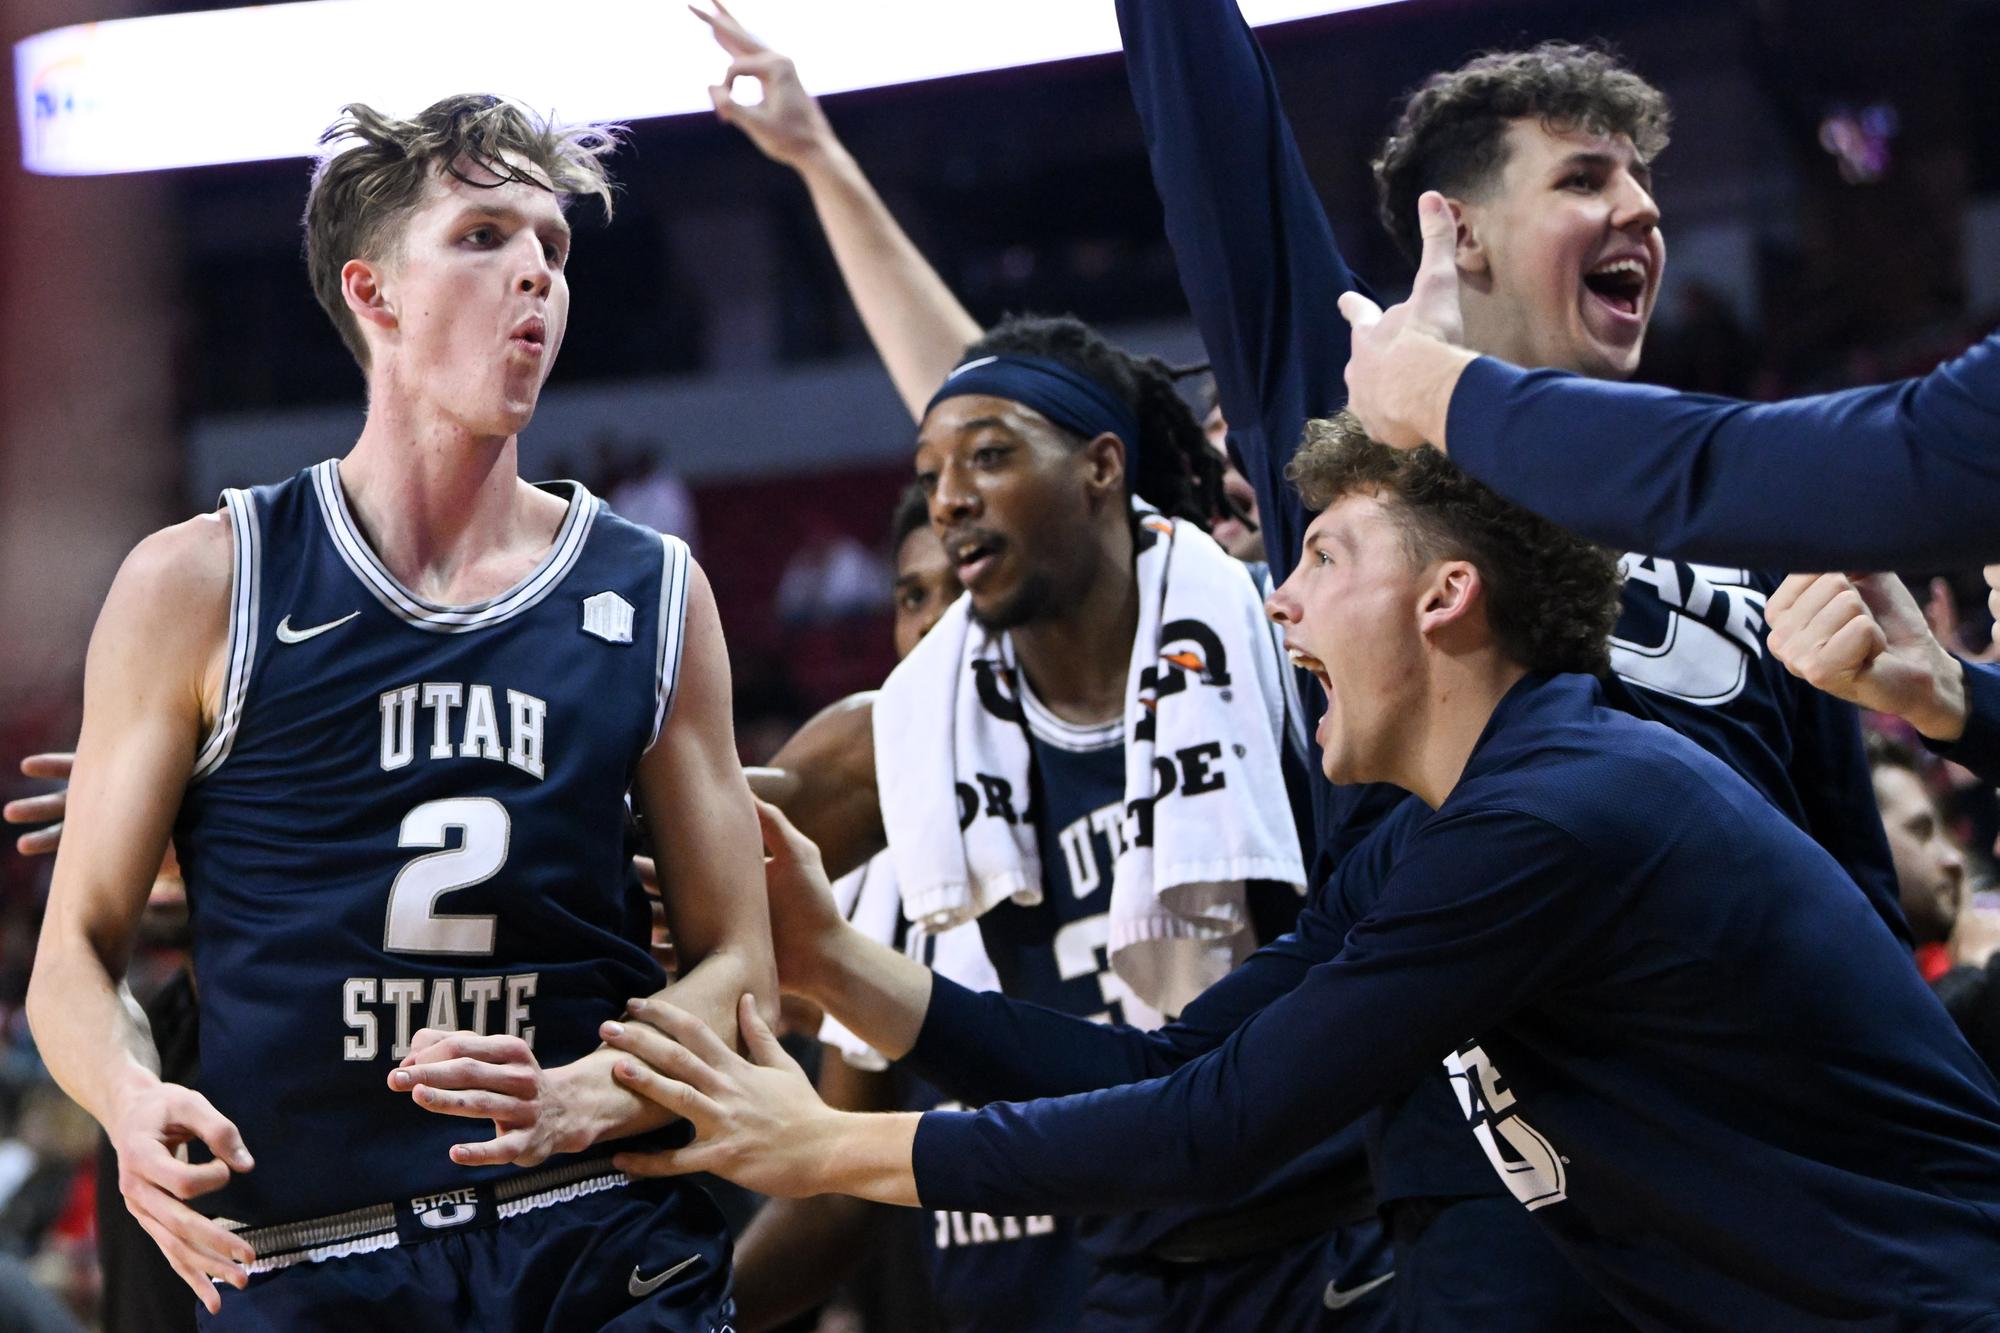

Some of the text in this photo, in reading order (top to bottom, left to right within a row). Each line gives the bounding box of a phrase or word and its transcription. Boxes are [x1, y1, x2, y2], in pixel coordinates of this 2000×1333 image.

[379, 682, 547, 781] UTAH
[382, 796, 511, 956] 2
[1058, 800, 1127, 900] UT
[343, 972, 540, 1061] STATE
[410, 1186, 480, 1216] STATE
